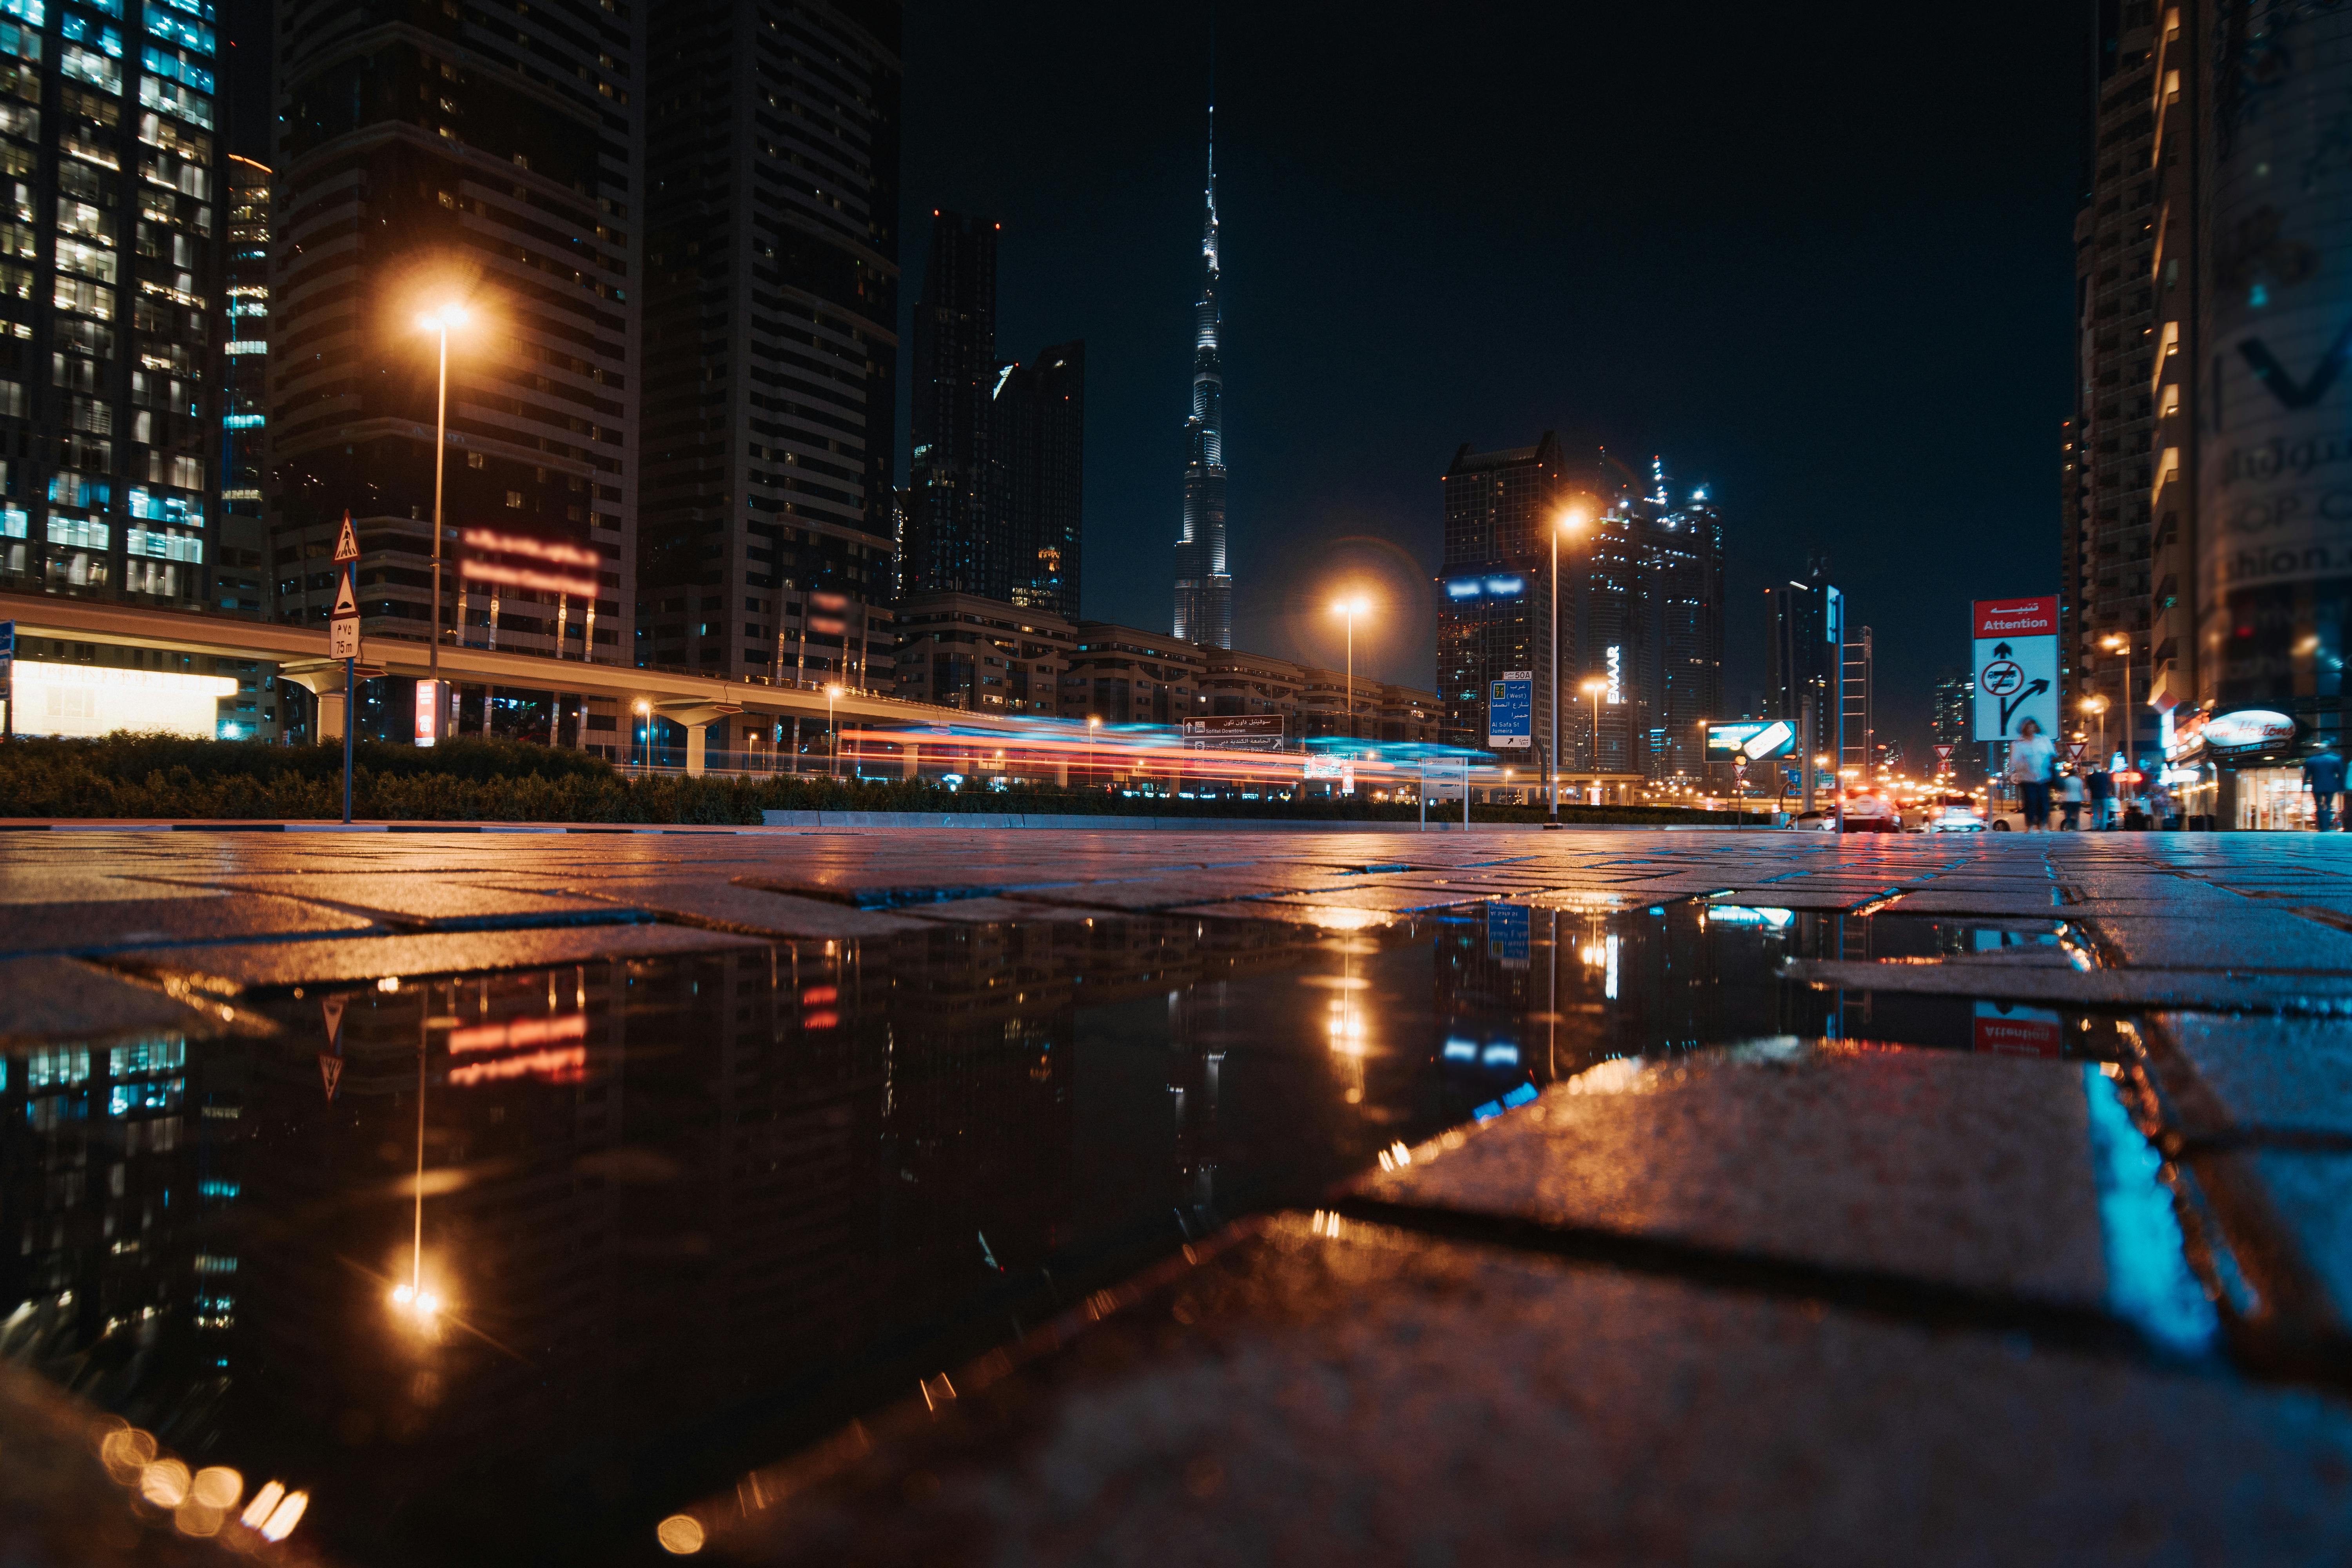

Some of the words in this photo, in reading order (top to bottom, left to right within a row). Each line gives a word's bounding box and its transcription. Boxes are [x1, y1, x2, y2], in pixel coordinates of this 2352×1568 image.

[1990, 603, 2039, 614] تنبيه
[1984, 617, 2047, 630] Attention
[336, 641, 344, 654] 75
[346, 643, 352, 653] m
[1607, 645, 1619, 704] EMAAR
[2209, 722, 2232, 739] Tim
[2239, 720, 2294, 737] Hortons
[2239, 744, 2263, 752] BAKE
